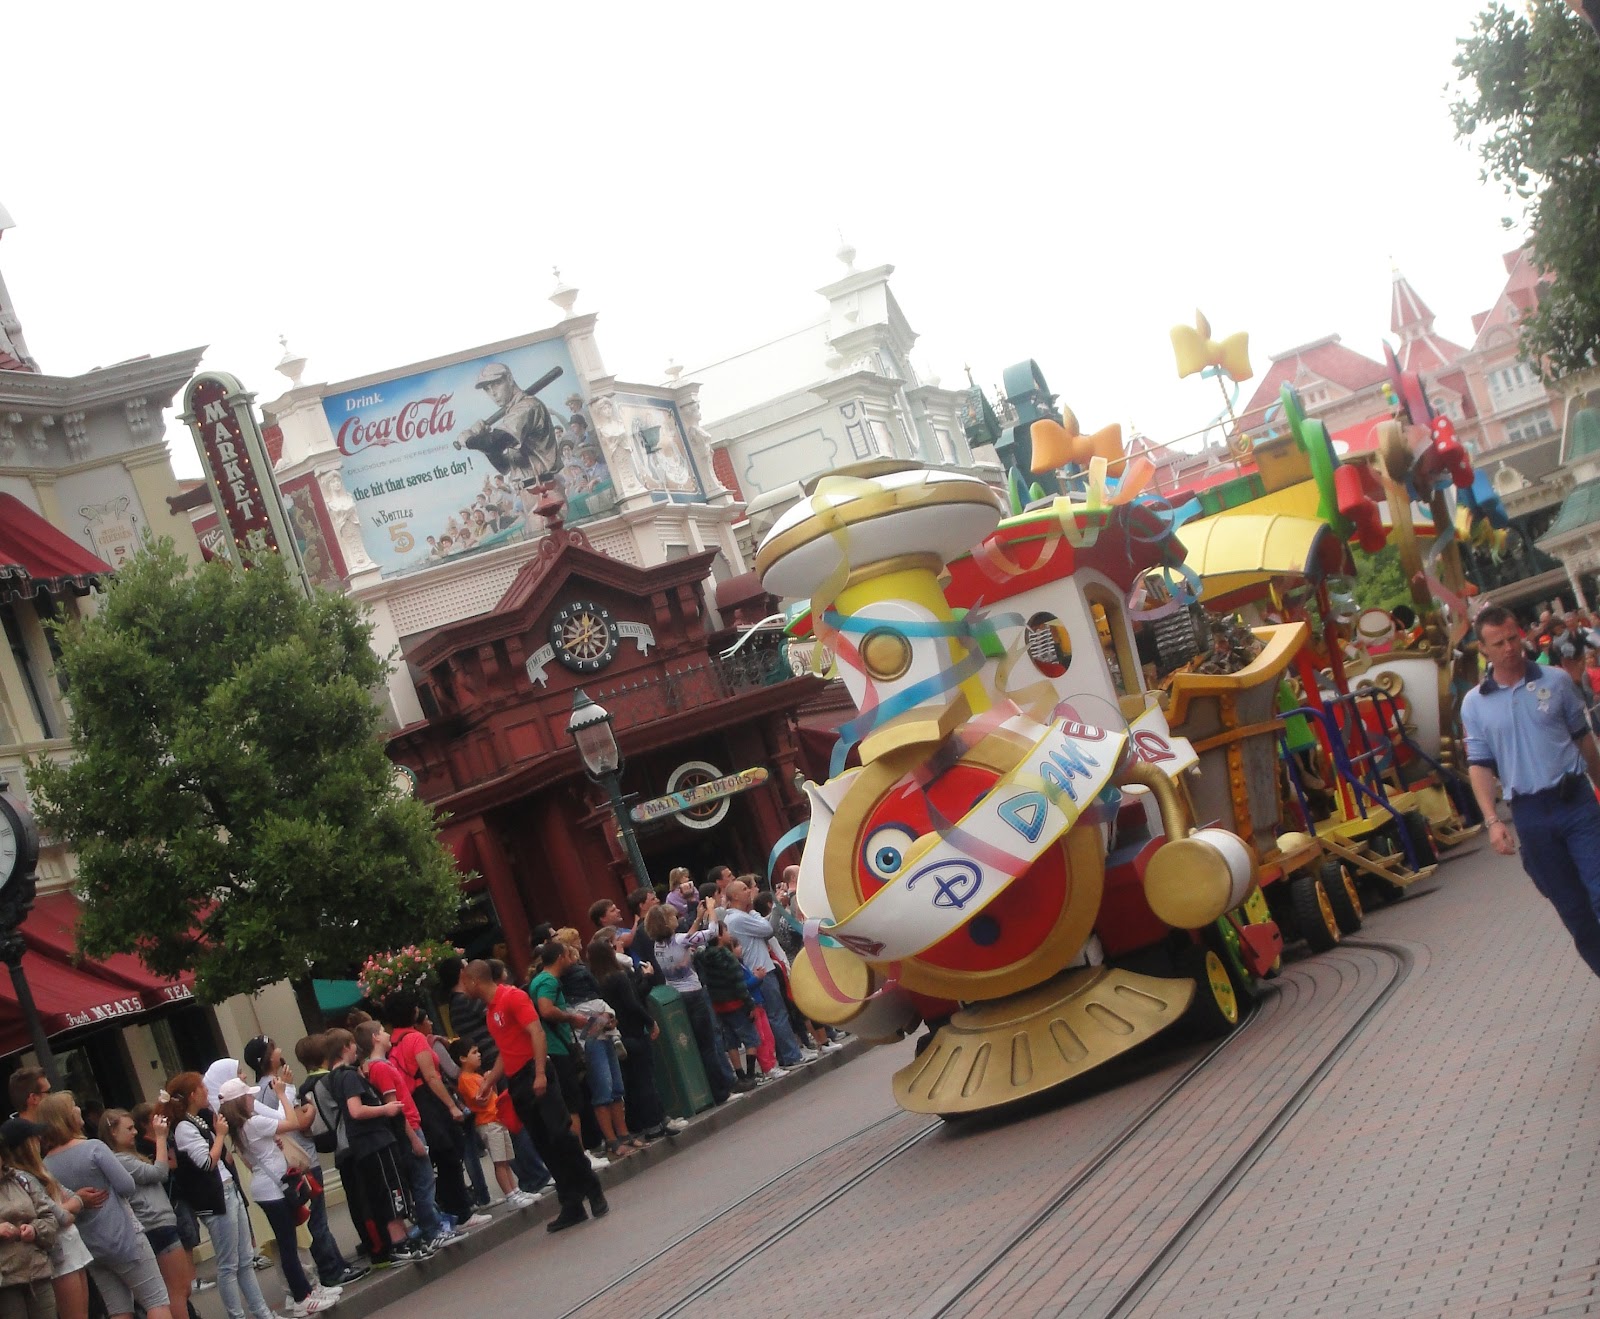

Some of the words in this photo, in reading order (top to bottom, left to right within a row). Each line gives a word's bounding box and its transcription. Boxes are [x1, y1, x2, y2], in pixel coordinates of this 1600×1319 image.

[346, 393, 384, 411] Drink
[337, 391, 456, 456] Coca-Cola
[203, 399, 254, 521] MARKET
[353, 488, 370, 501] the
[370, 482, 385, 497] hit
[385, 478, 406, 493] that
[406, 471, 433, 487] saves
[433, 465, 450, 479] the
[620, 625, 642, 635] TRADE
[643, 627, 652, 637] IN
[527, 656, 542, 673] TIME
[541, 648, 551, 660] TO
[647, 796, 680, 814] MAIN
[703, 775, 752, 797] MOTORS
[164, 984, 192, 1000] TEA
[65, 1010, 91, 1026] Fresh
[90, 997, 142, 1019] MEATS
